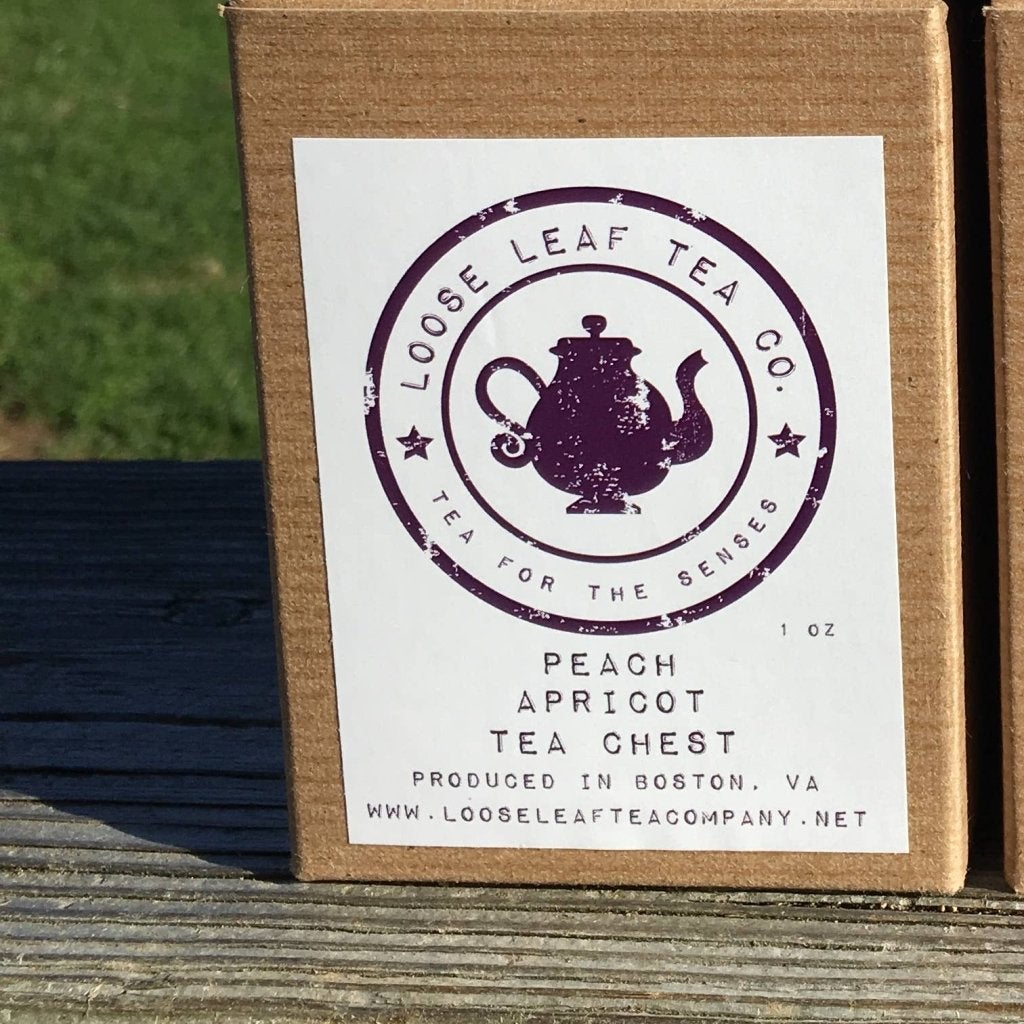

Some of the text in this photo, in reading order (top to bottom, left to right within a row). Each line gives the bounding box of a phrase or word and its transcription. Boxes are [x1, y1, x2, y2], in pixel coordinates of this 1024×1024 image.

[399, 224, 797, 393] LOOSE LEAF TEA CO.
[432, 489, 778, 602] TEA FOR THE SENSES
[780, 623, 835, 637] 1 OZ
[543, 652, 675, 677] PEACH
[517, 689, 705, 715] APRICOT
[489, 729, 736, 756] TEA CHEST
[412, 771, 555, 790] PRODUCED
[581, 773, 611, 791] IN
[786, 774, 819, 792] VA
[366, 802, 867, 828] WWW.LOOSELEAFTEACOMPANY.NET
